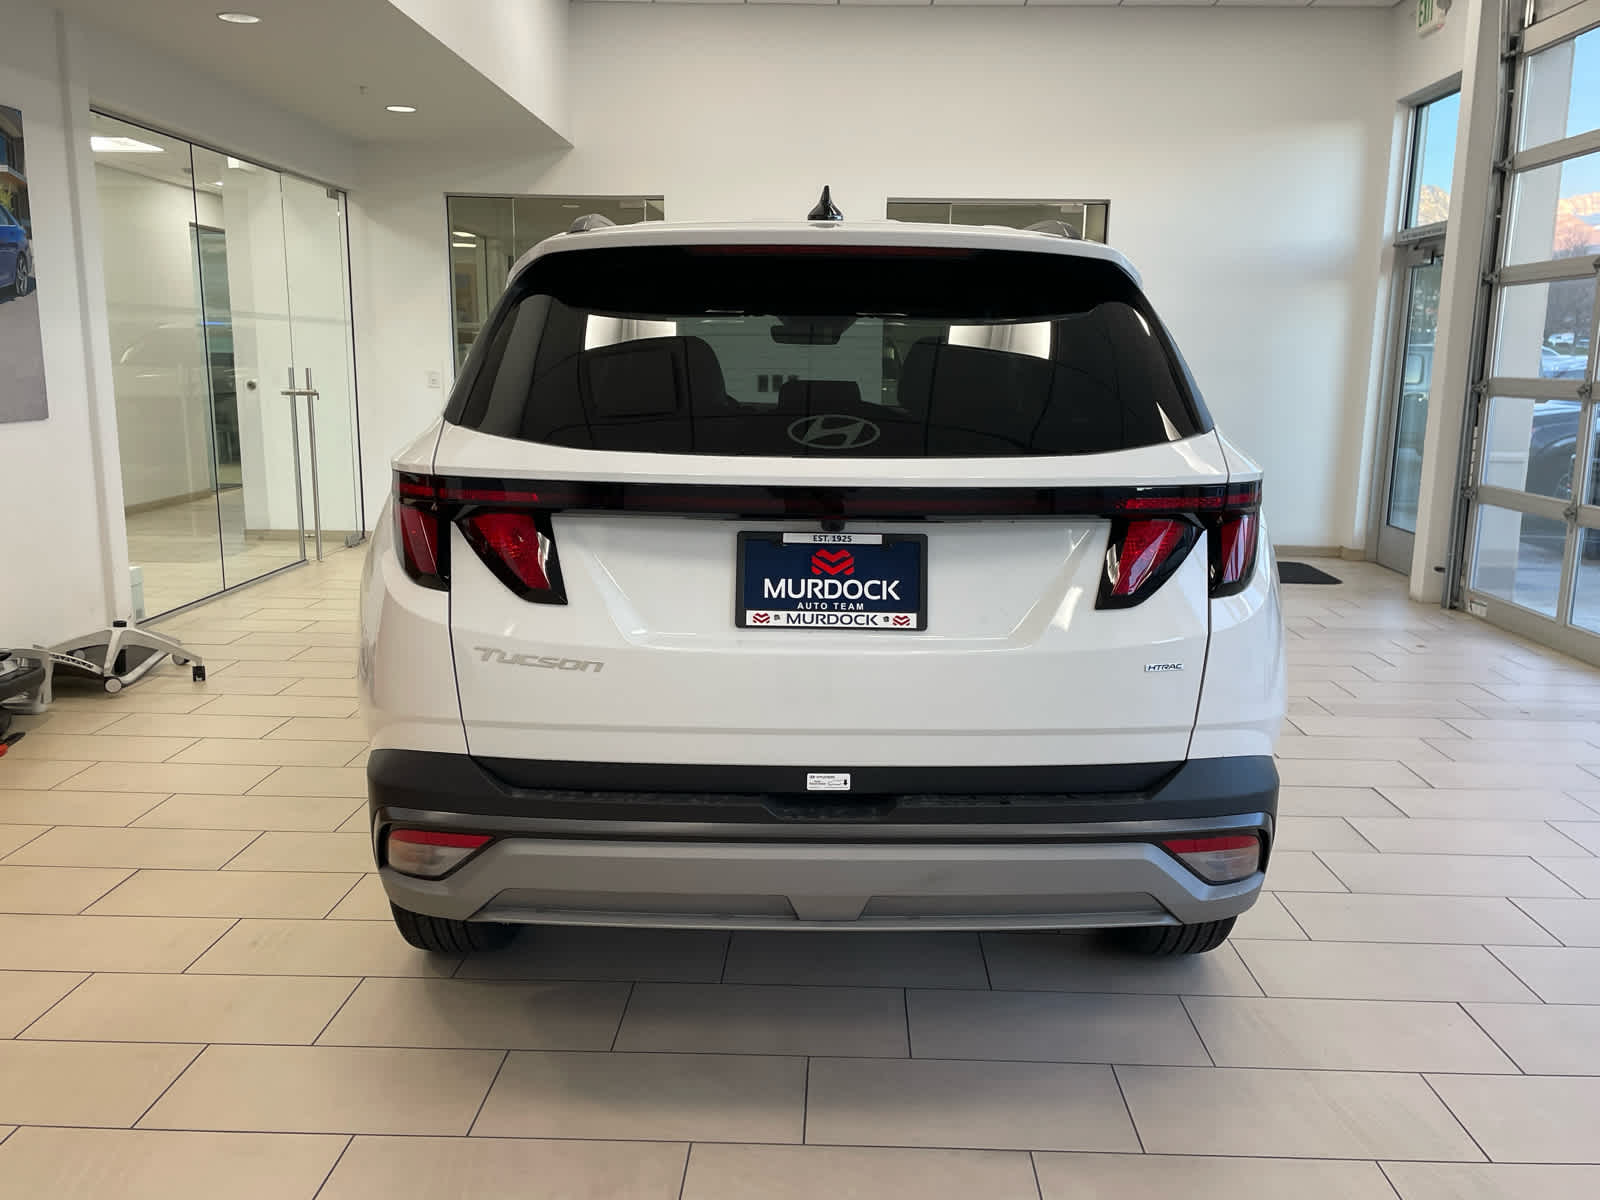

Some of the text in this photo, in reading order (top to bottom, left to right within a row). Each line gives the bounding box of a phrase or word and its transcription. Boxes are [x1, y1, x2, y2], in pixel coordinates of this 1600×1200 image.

[813, 535, 852, 543] EST. 1925
[763, 578, 901, 601] MURDOCK
[797, 602, 864, 610] AUTO TEAM
[786, 613, 879, 626] MURDOCK
[1147, 663, 1183, 671] HTRAC
